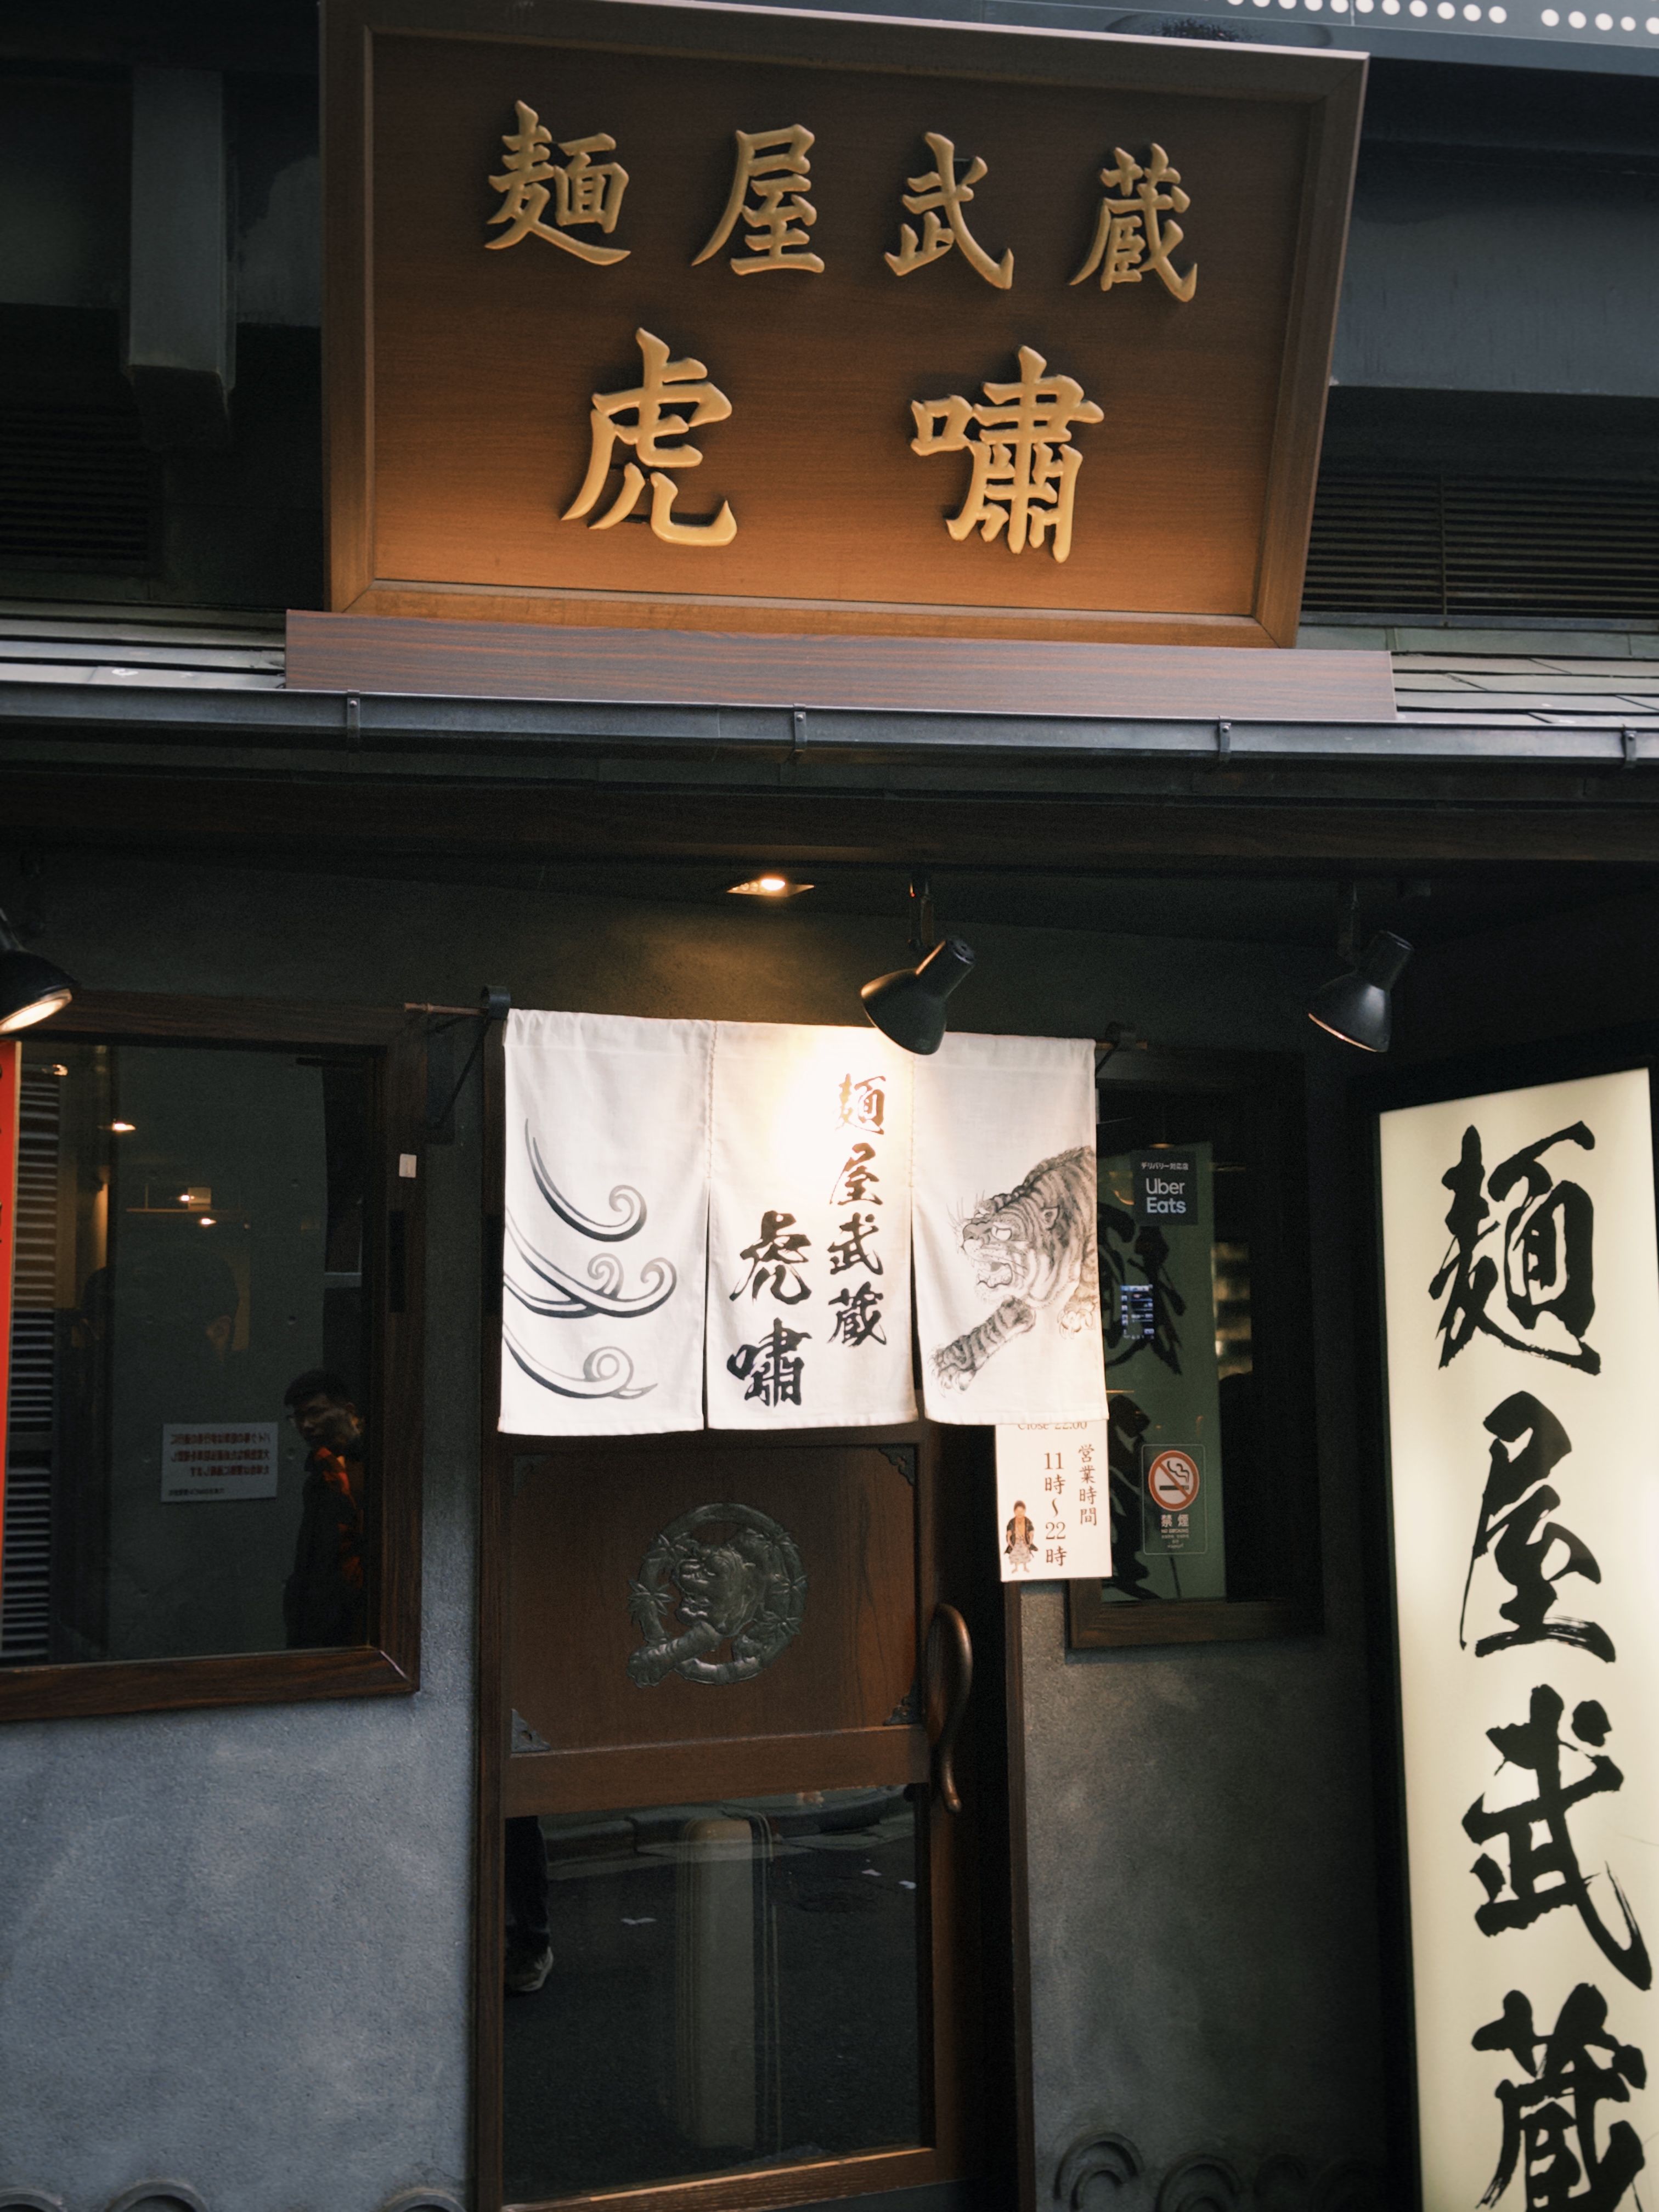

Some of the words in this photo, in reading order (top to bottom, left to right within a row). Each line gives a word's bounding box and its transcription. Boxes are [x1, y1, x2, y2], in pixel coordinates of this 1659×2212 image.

[486, 100, 1198, 303] 麺屋武蔵
[561, 328, 1105, 564] 虎嘯
[1141, 1162, 1189, 1171] デリバリー対応店
[1146, 1178, 1186, 1194] Uber
[1146, 1197, 1187, 1214] Eats
[827, 1073, 888, 1347] 麺屋武蔵
[726, 1210, 812, 1407] 虎嘯
[1078, 1443, 1098, 1526] 営業時間
[1160, 1514, 1190, 1528] 禁煙
